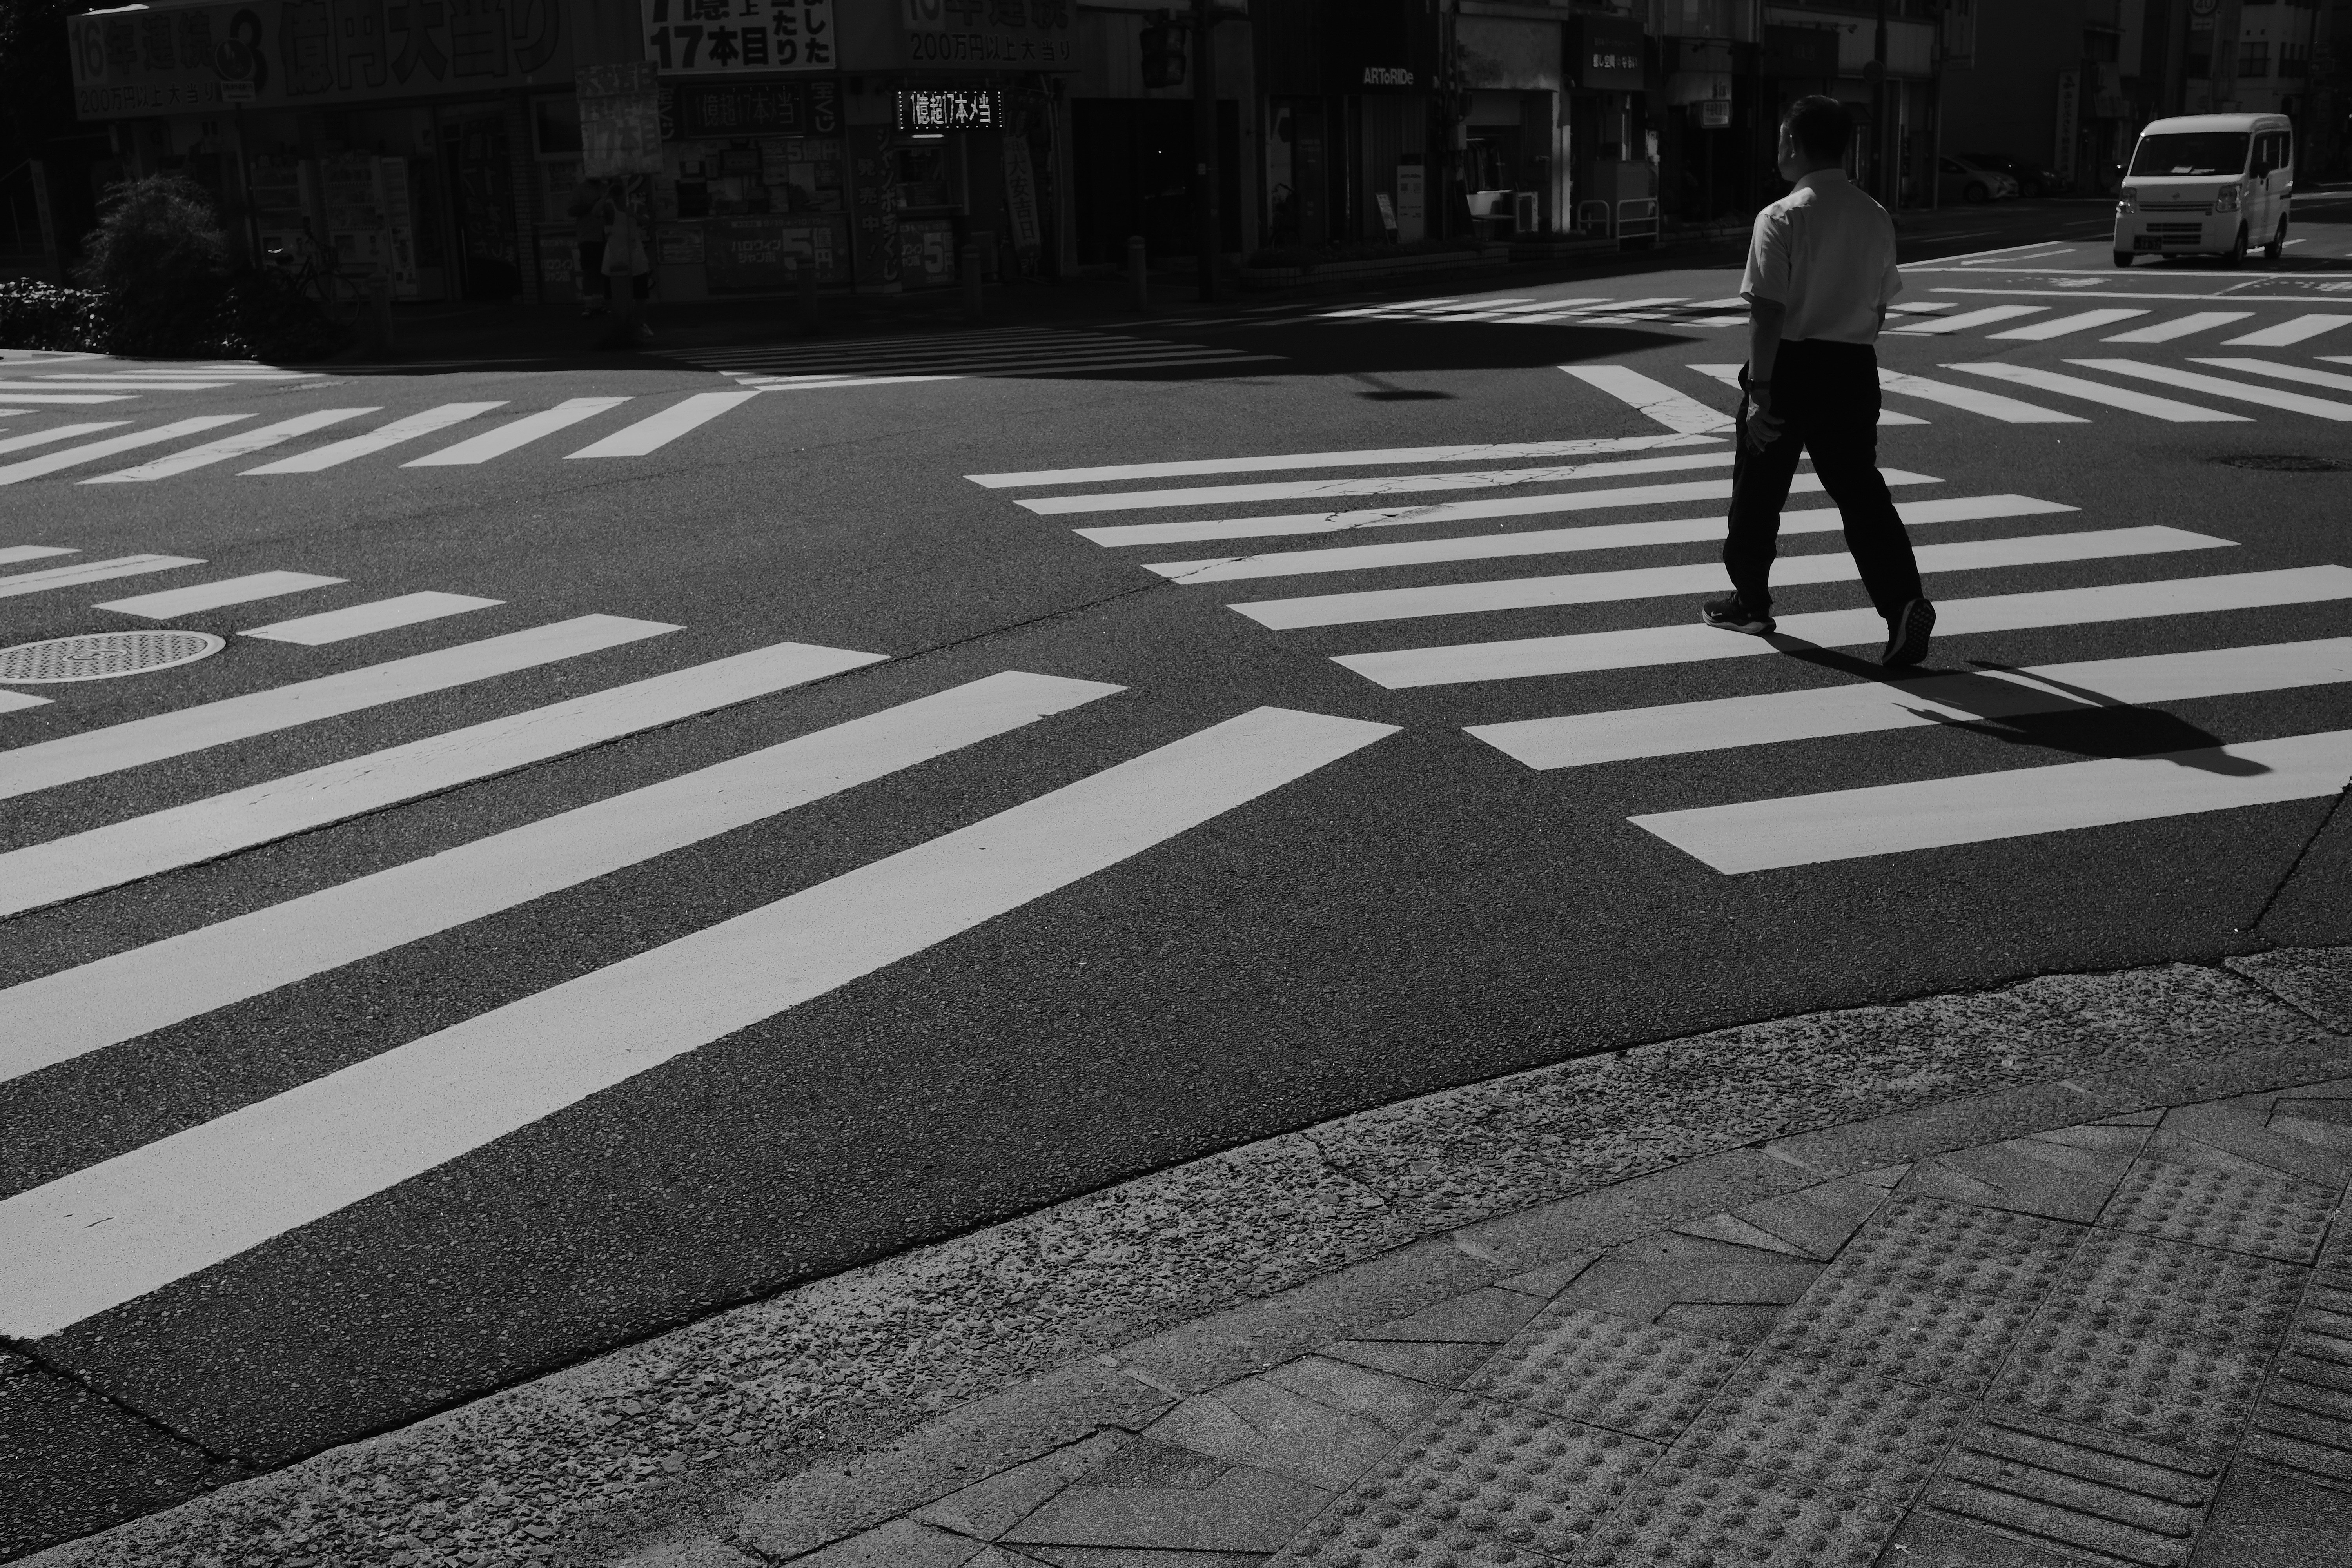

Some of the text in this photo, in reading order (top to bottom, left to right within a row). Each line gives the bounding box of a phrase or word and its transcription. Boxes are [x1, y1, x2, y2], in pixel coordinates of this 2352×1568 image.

[71, 10, 212, 81] 16年連続
[650, 25, 769, 69] 17本目
[804, 0, 830, 64] した
[911, 33, 1070, 61] 200万円以上大当り
[80, 81, 214, 113] 200万円以上大当り
[1363, 67, 1414, 84] ARToRIDe
[811, 81, 835, 132] 宝くじ
[877, 129, 898, 281] ジャンボ宝くじ
[1007, 156, 1035, 242] 大安吉日
[731, 239, 781, 252] ハロウィン
